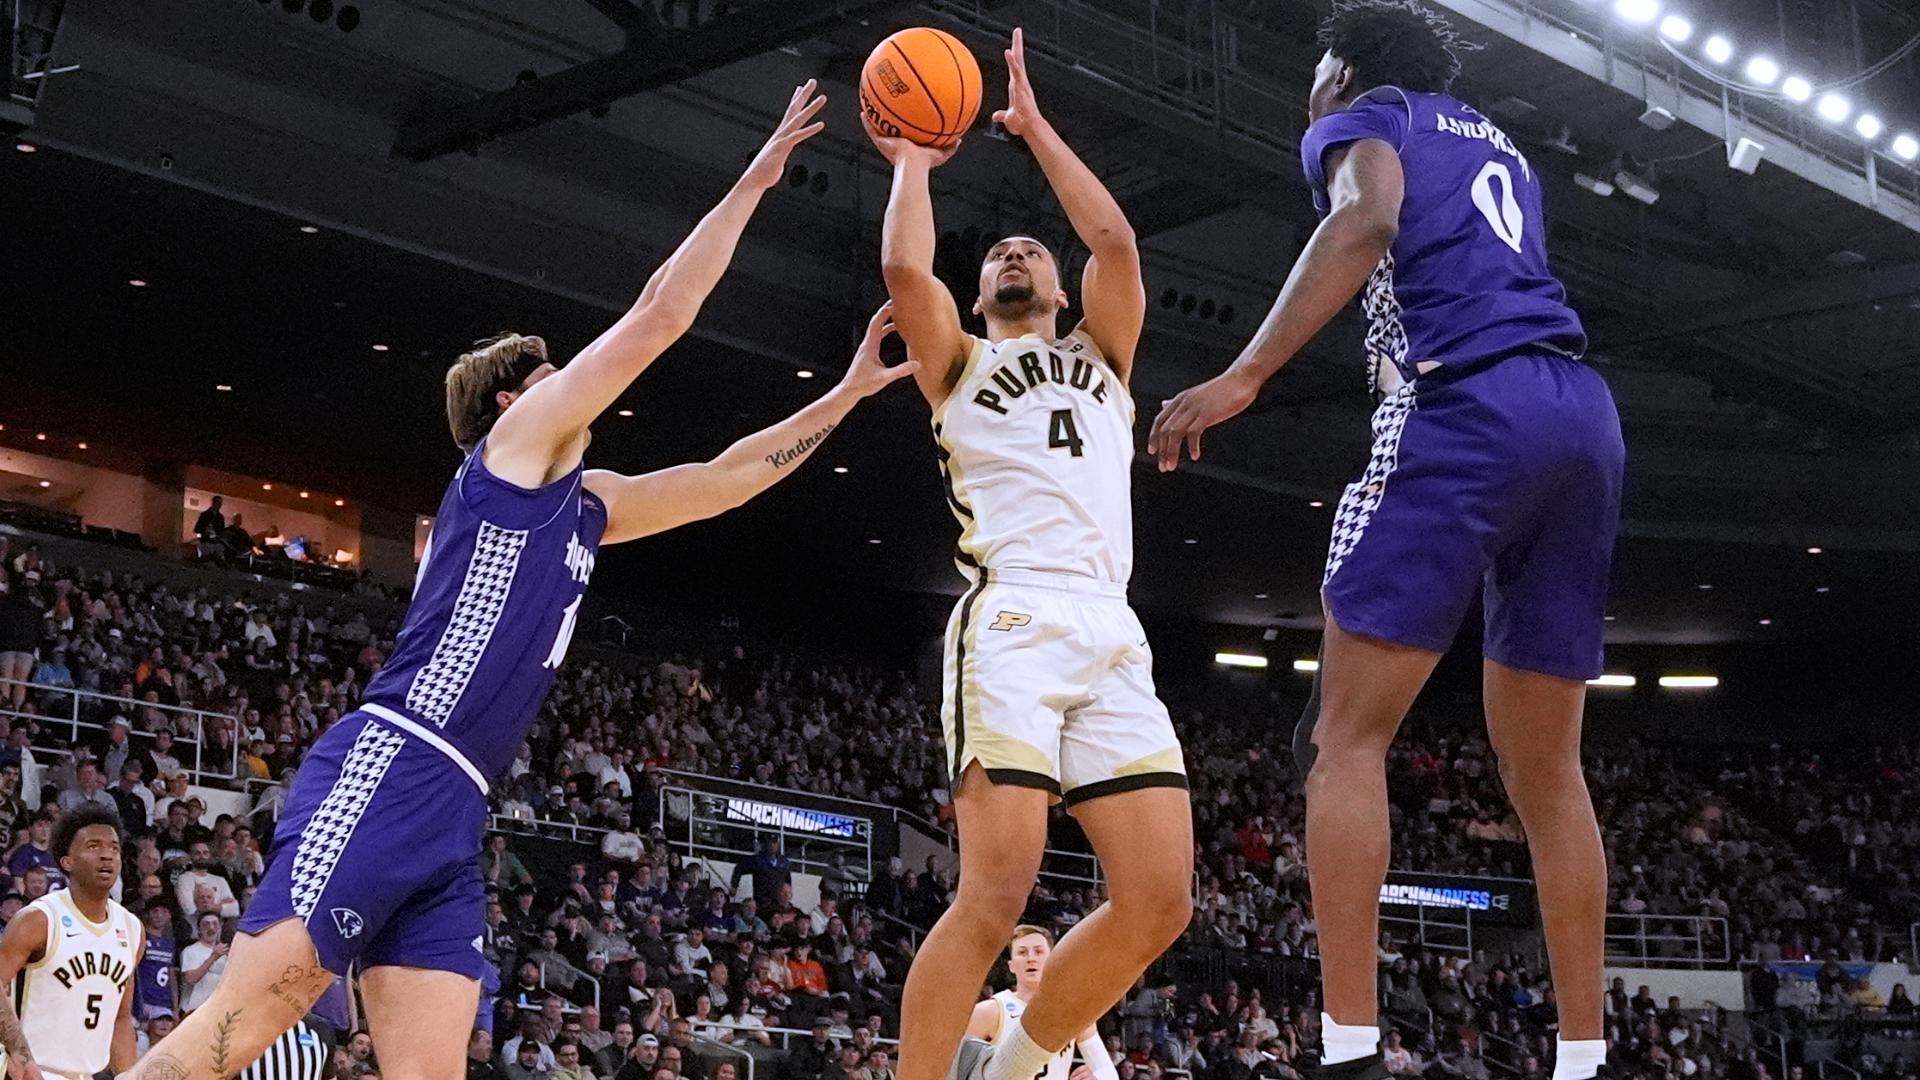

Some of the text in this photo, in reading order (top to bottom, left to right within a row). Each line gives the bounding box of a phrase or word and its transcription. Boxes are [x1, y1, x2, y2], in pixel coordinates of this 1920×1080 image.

[1471, 160, 1524, 254] 0
[973, 351, 1108, 415] PURDUE
[765, 423, 835, 469] Kindness
[1049, 408, 1084, 457] 4
[988, 610, 1033, 631] P
[157, 966, 169, 987] 6
[84, 994, 103, 1030] 5
